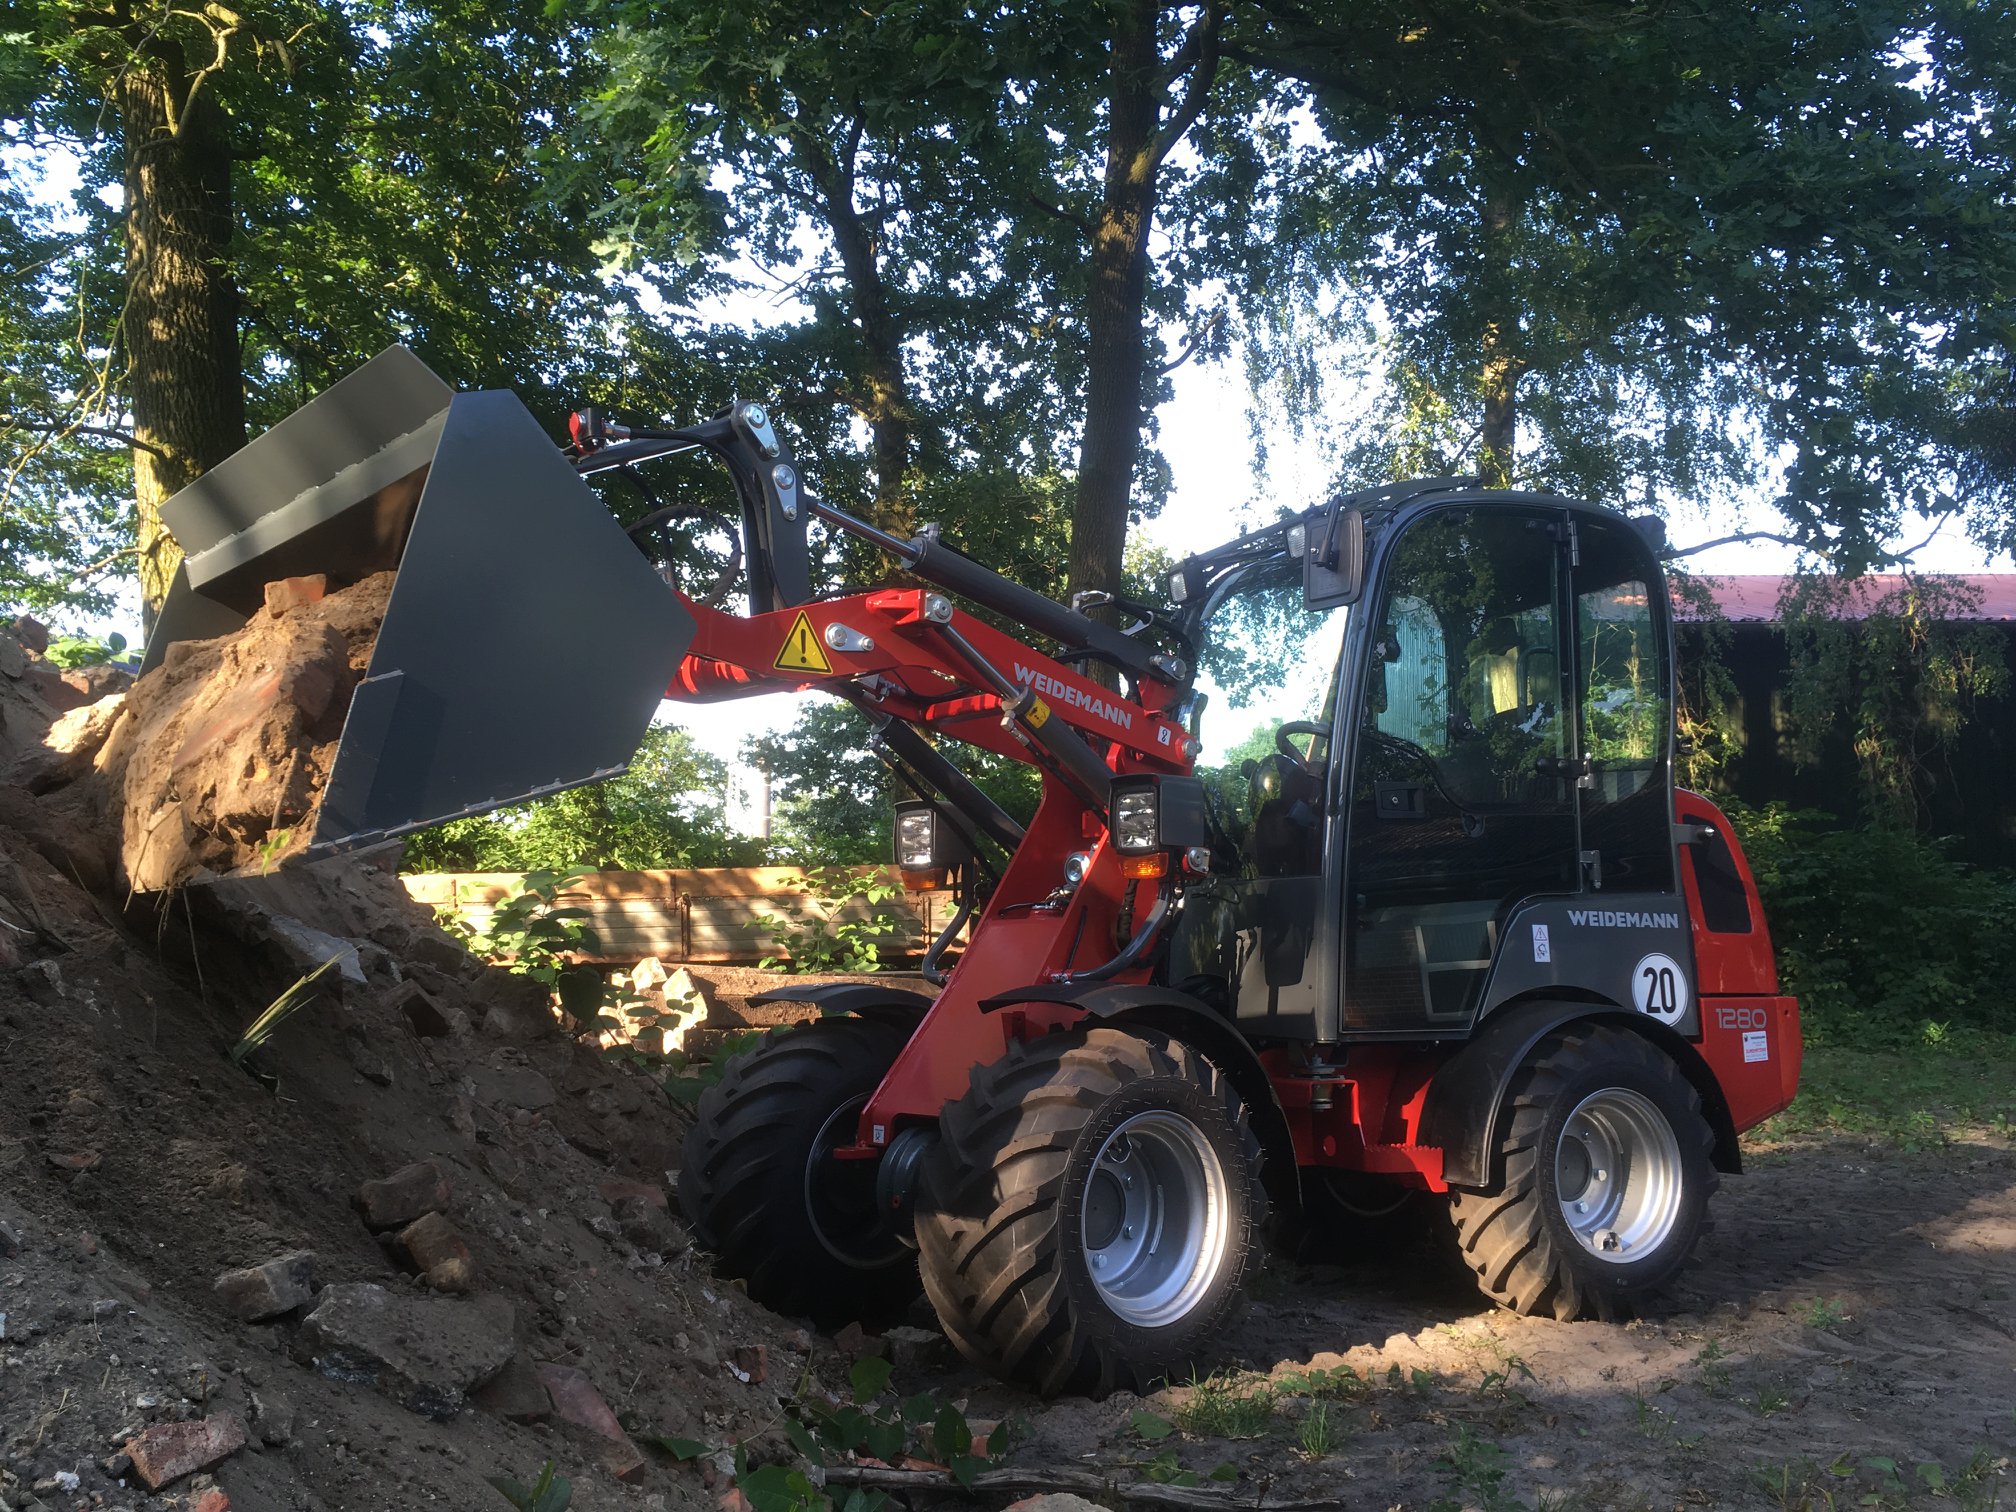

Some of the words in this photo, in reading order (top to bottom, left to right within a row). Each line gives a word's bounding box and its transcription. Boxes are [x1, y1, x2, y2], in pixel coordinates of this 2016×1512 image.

[1013, 662, 1132, 730] WEIDEMANN
[1567, 910, 1679, 929] WEIDEMANN
[1643, 967, 1677, 1014] 20
[1715, 1008, 1767, 1029] 1280
